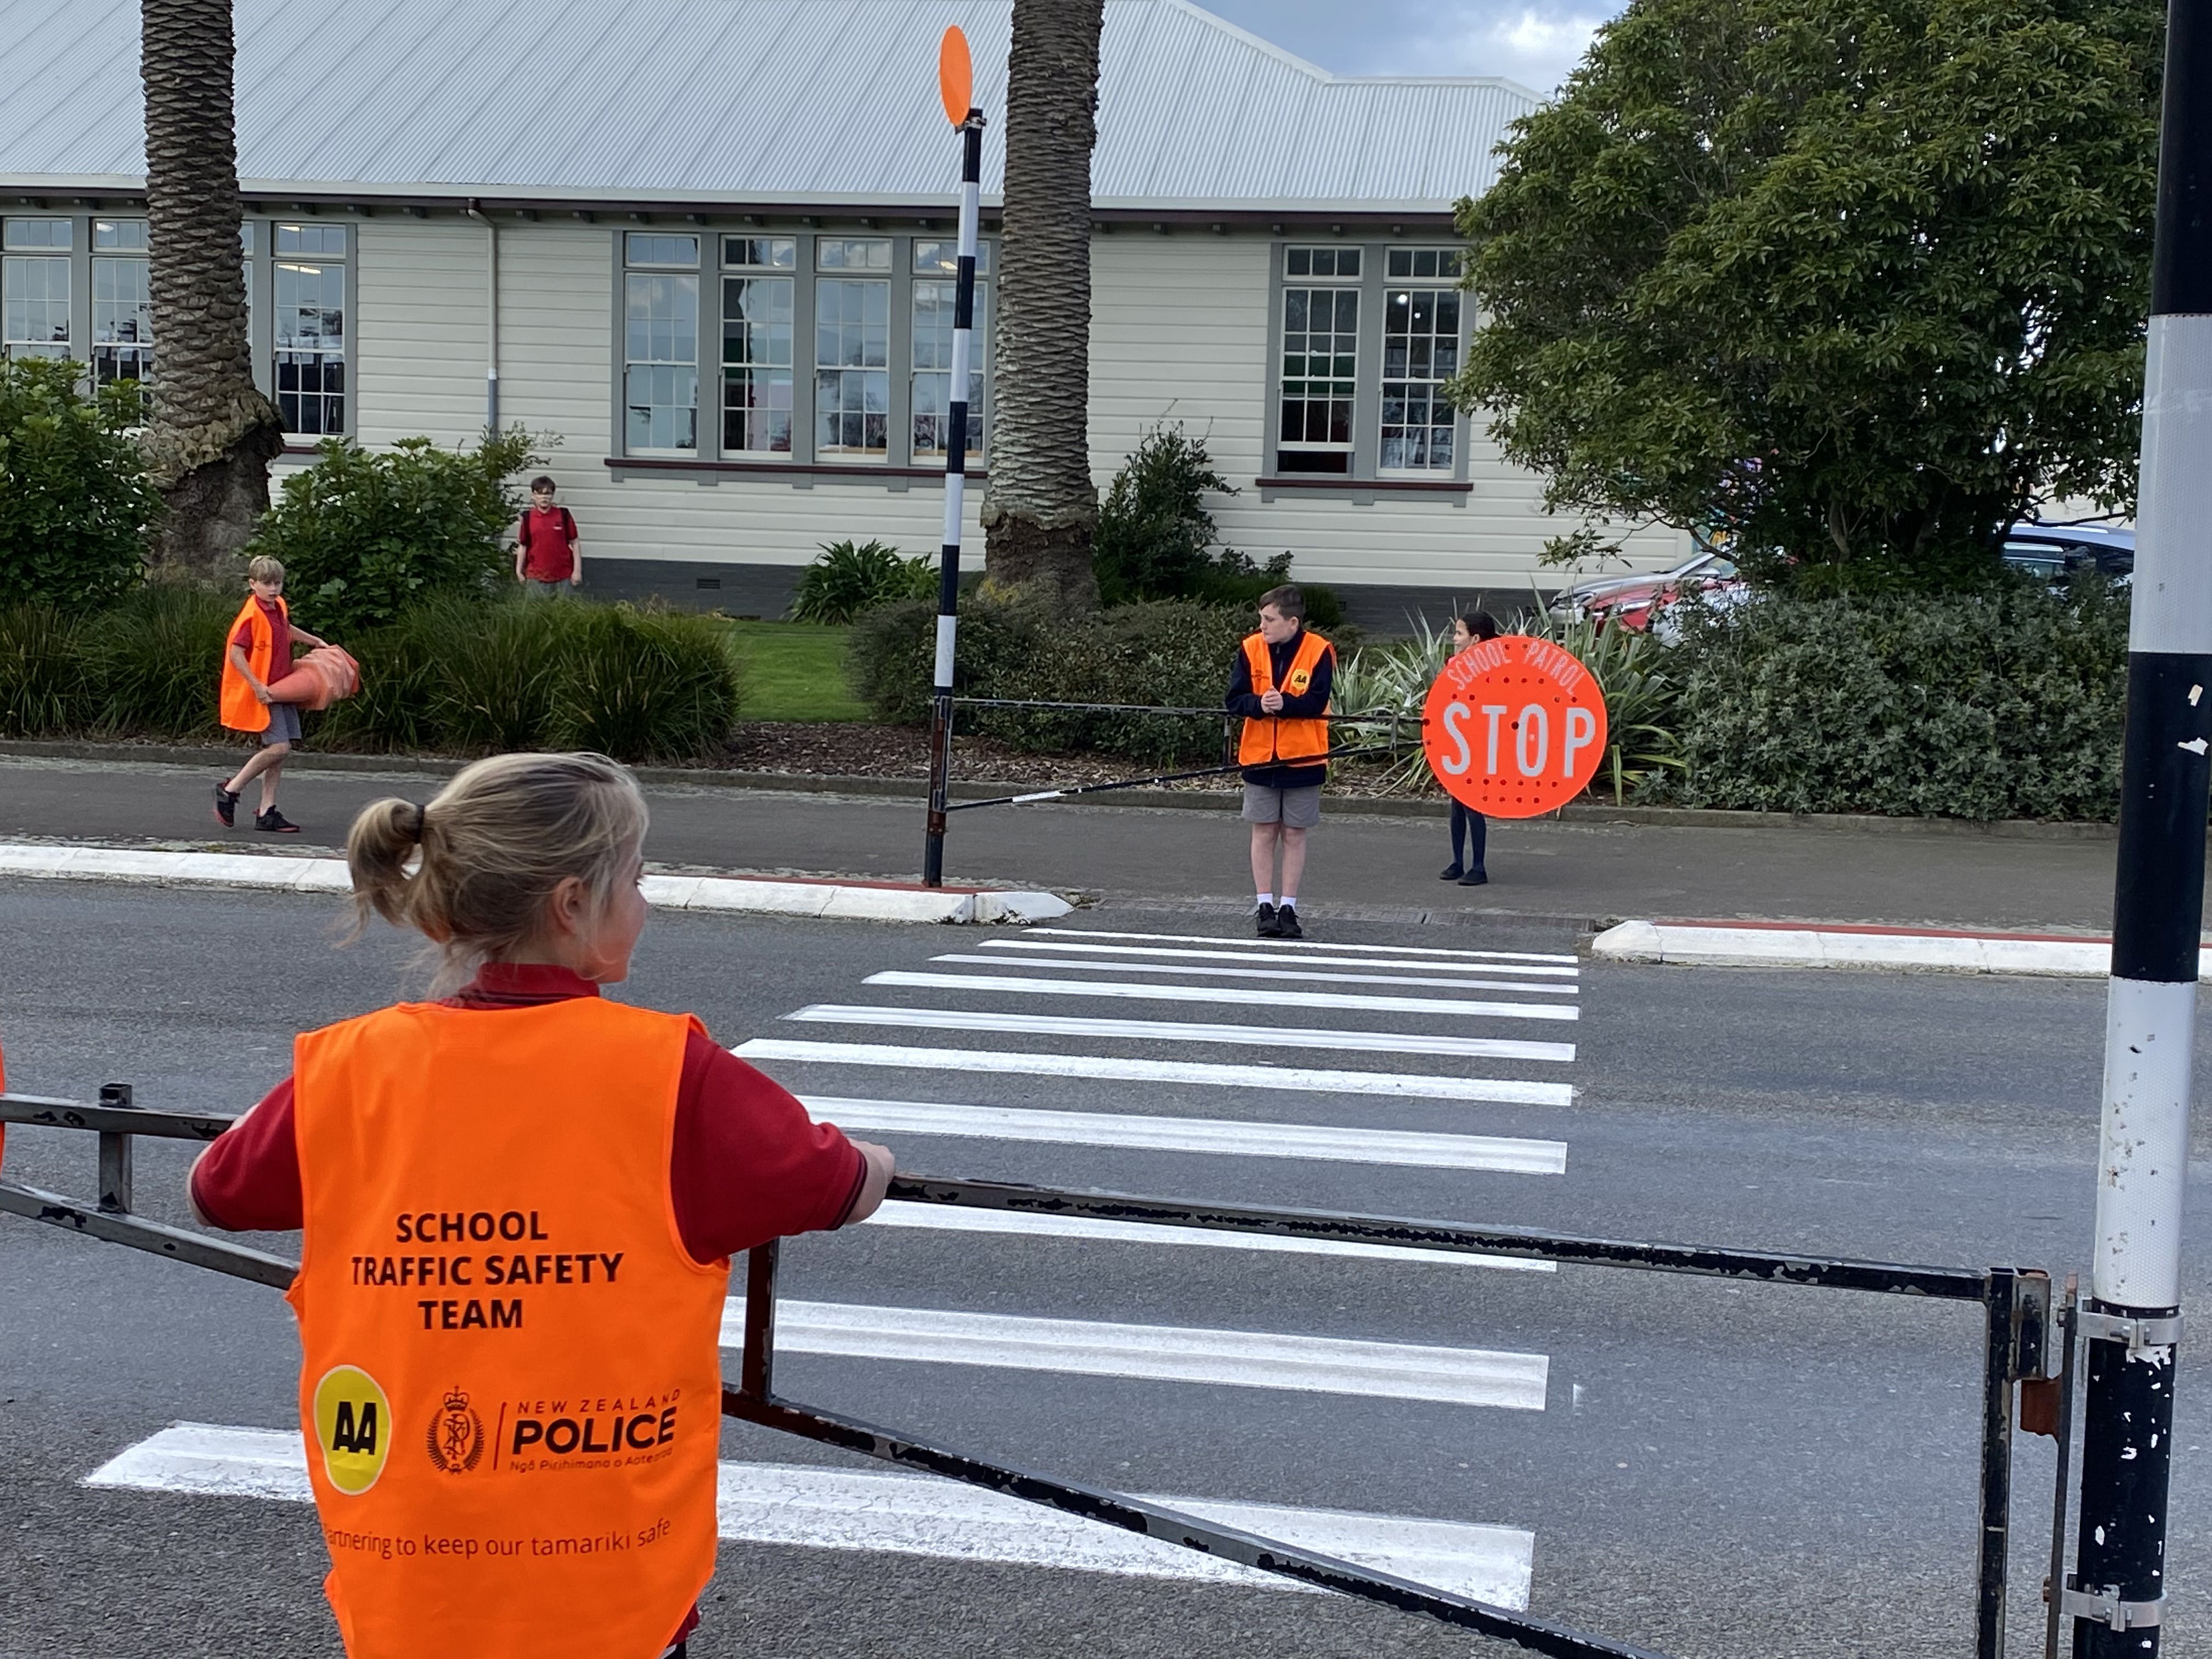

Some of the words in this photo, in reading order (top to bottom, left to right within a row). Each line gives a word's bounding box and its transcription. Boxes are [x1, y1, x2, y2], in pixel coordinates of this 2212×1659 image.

[1294, 674, 1307, 684] AA
[1447, 640, 1512, 691] SCHOOL
[1522, 640, 1585, 695] PATROL
[1441, 701, 1596, 778] STOP
[396, 1211, 549, 1243] SCHOOL
[352, 1256, 472, 1286] TRAFFIC
[485, 1252, 624, 1285] SAFETY
[417, 1299, 523, 1330] TEAM
[517, 1400, 568, 1414] NEW
[579, 1388, 680, 1413] ZEALAND
[332, 1401, 376, 1455] AA
[512, 1406, 677, 1454] POLICE
[613, 1459, 622, 1468] o
[396, 1536, 416, 1556] to
[424, 1534, 478, 1560] keep
[485, 1539, 524, 1555] our
[531, 1531, 631, 1556] tamariki
[637, 1517, 671, 1547] safe
